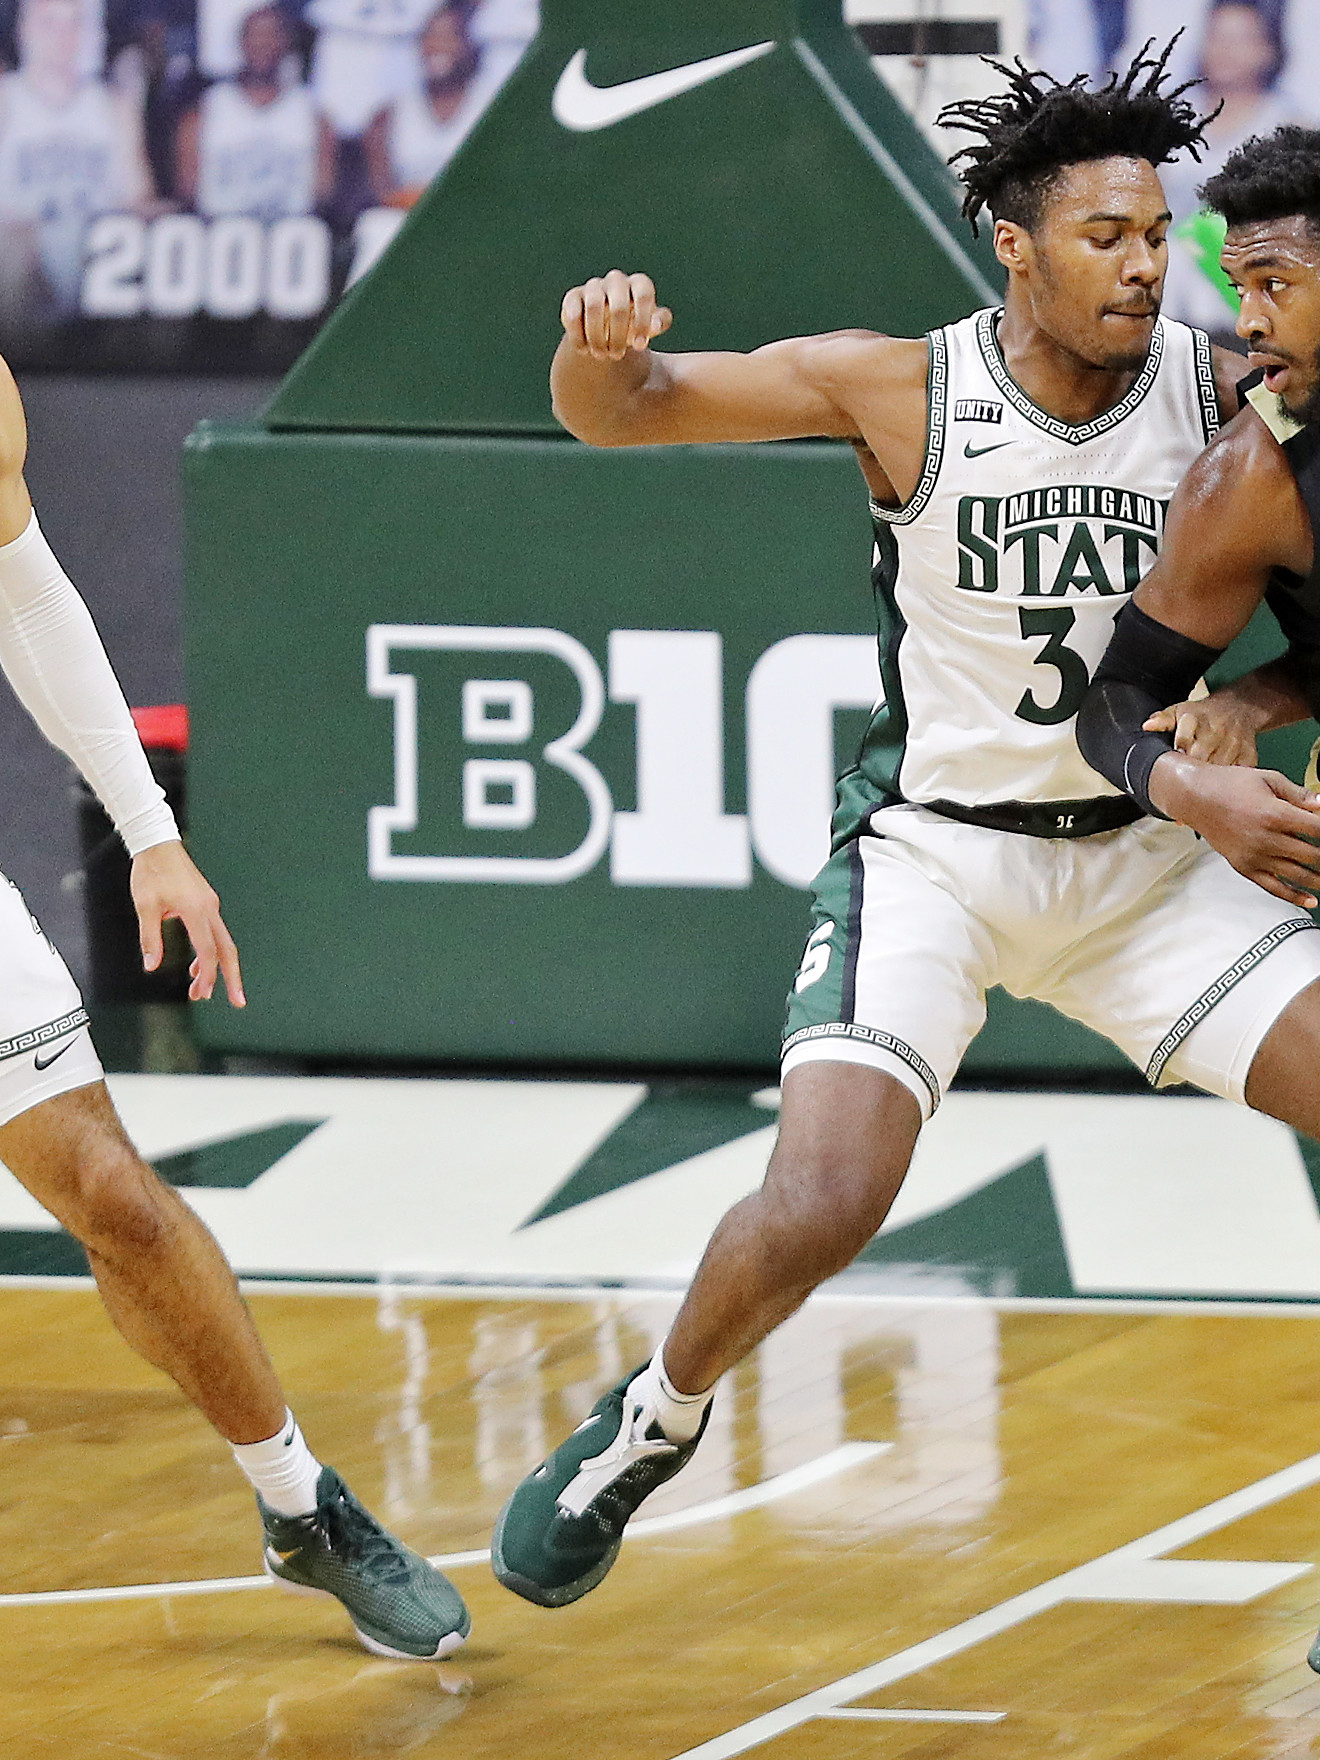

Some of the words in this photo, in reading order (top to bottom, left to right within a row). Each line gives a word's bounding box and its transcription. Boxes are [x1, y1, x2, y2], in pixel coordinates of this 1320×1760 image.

[82, 212, 331, 320] 2000
[955, 400, 1002, 421] UNITY
[1008, 486, 1152, 526] MICHIGAN
[954, 495, 1170, 596] STAT
